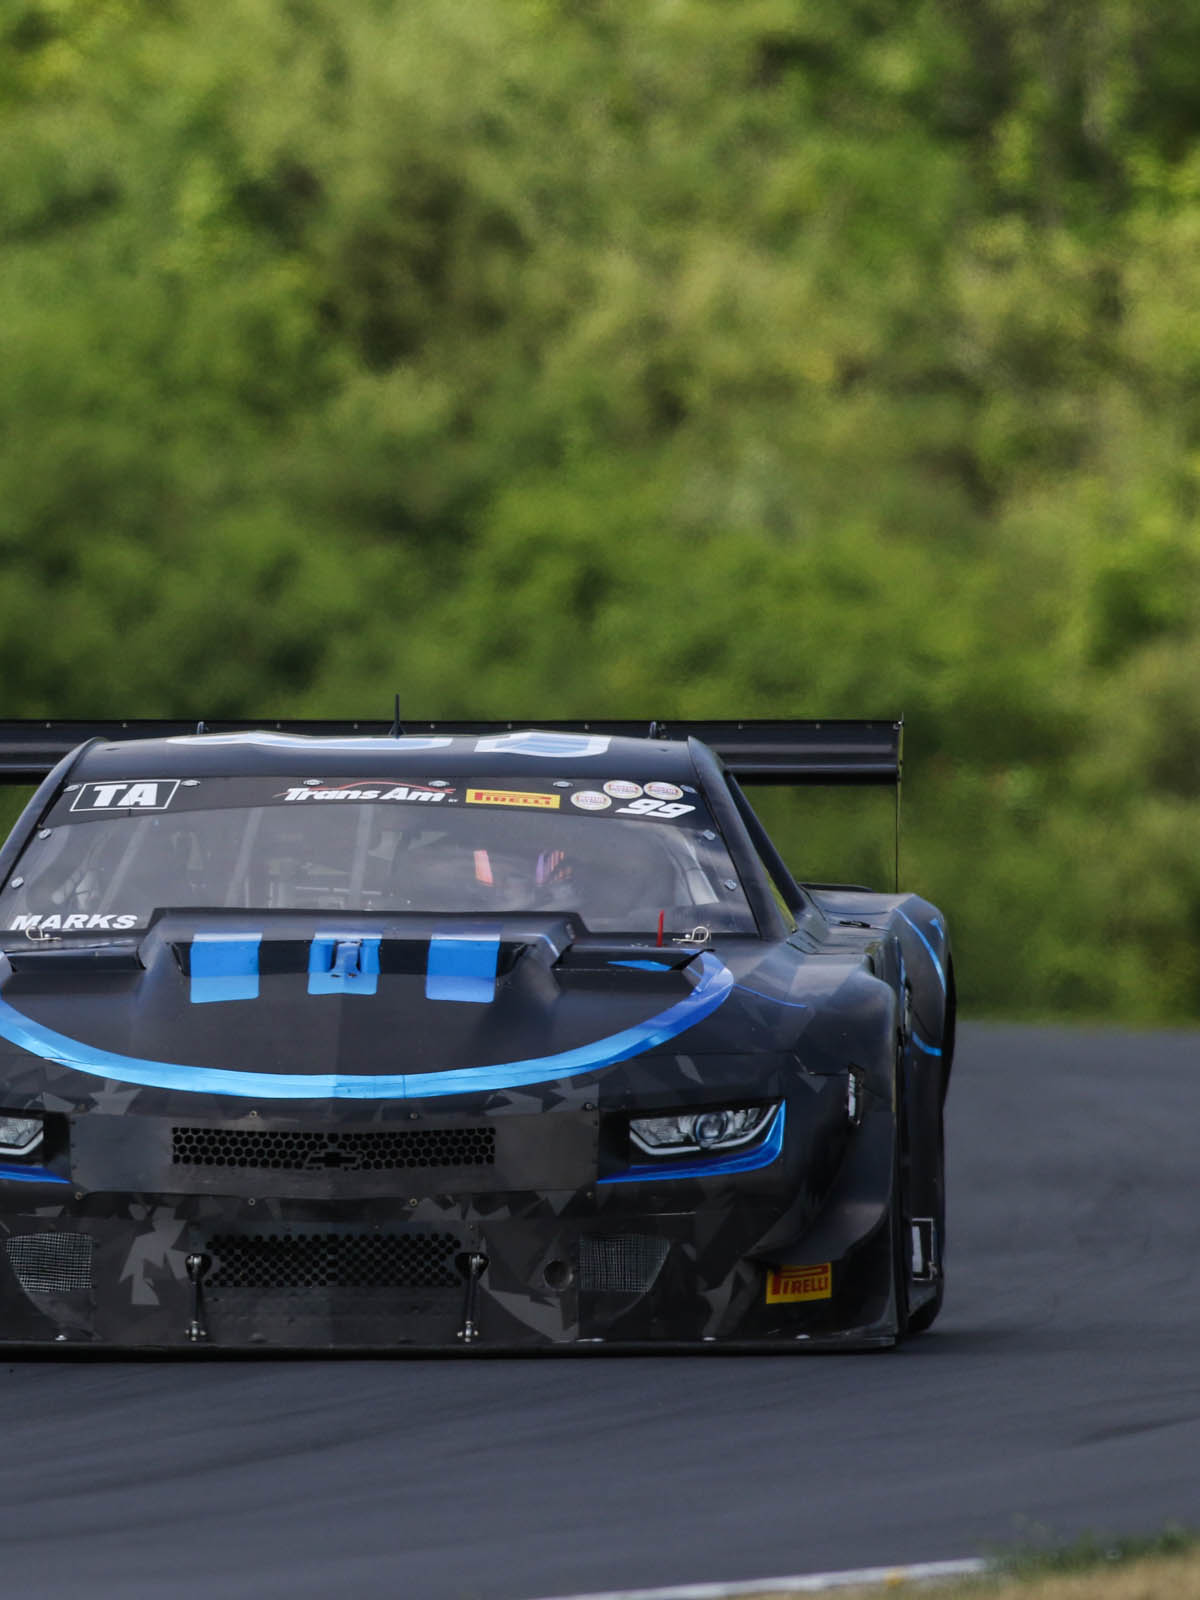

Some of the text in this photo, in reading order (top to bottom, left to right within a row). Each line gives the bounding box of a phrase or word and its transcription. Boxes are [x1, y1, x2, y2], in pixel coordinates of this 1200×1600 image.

[93, 783, 158, 807] TA
[284, 787, 446, 802] Trans Am
[474, 792, 553, 805] PIRELLI
[615, 798, 696, 818] 99
[10, 914, 138, 930] MARKS
[771, 1264, 829, 1297] PIRELLI
